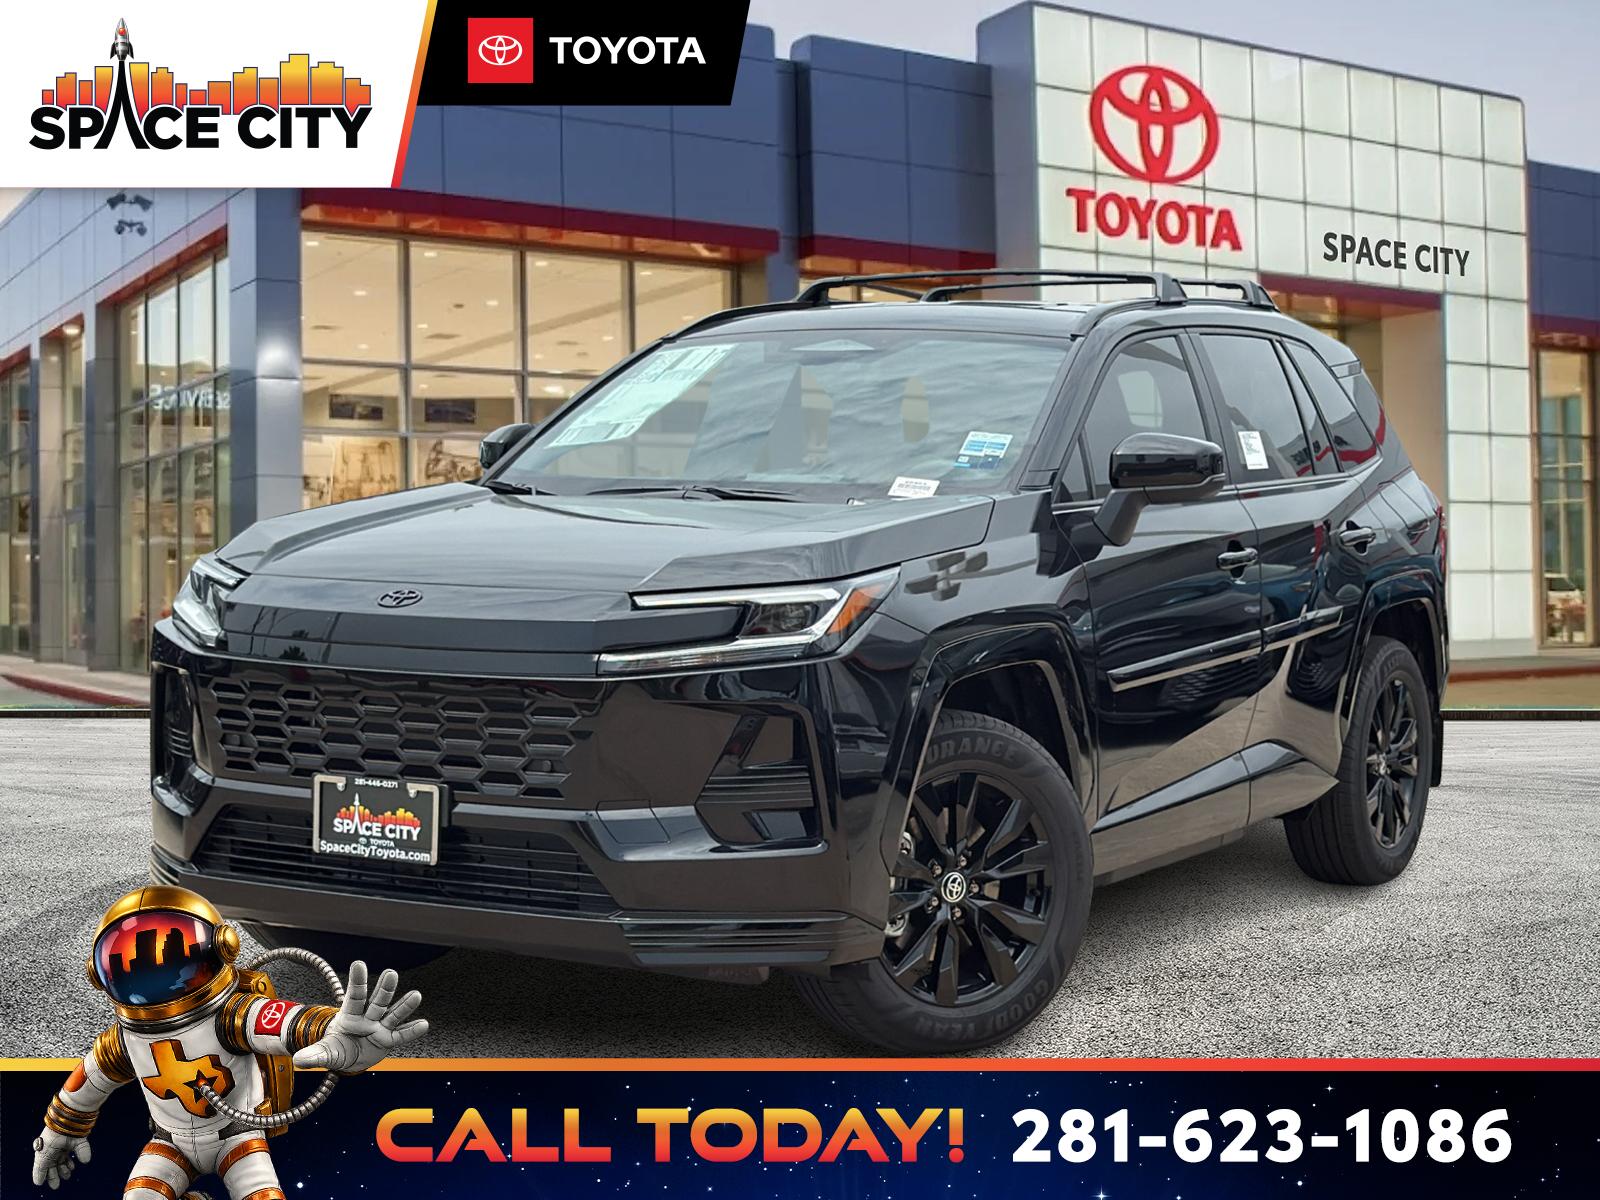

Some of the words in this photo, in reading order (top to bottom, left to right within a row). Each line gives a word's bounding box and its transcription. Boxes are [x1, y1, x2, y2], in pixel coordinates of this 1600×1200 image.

[1065, 188, 1243, 251] TOYOTA
[1322, 231, 1407, 270] SPACE
[1414, 243, 1471, 277] CITY
[926, 736, 1017, 764] URANCE
[333, 817, 382, 837] SPACE
[385, 824, 421, 841] CITY
[320, 840, 431, 862] SpaceCityToyota.com
[369, 838, 395, 848] TOYOTA
